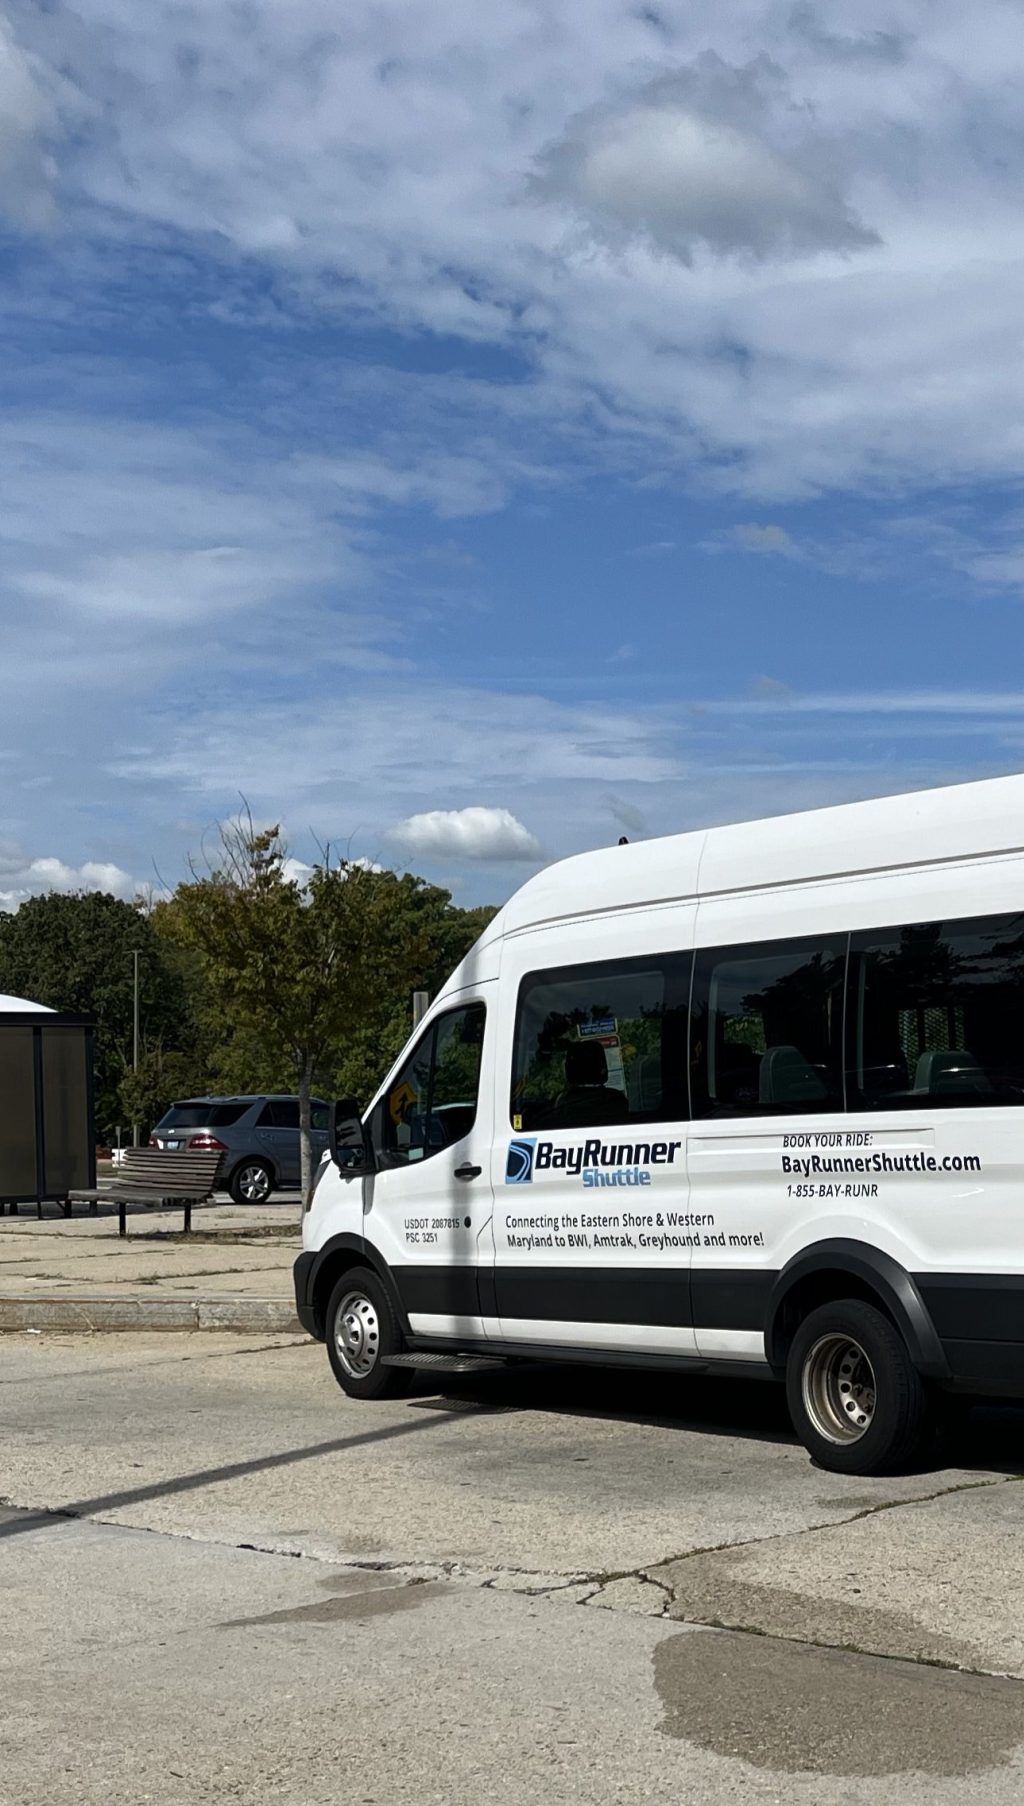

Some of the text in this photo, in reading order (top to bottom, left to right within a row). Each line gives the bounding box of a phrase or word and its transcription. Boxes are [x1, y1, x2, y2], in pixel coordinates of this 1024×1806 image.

[782, 1133, 874, 1148] BOOK YOUR RIDE:
[535, 1139, 682, 1176] BayRunner
[781, 1152, 982, 1178] BayRunnerShuttle.com
[582, 1167, 652, 1188] Shuttle
[787, 1184, 879, 1198] 1-855-BAY-RUNR
[404, 1218, 429, 1229] USDOT
[505, 1212, 715, 1232] Connecting the Eastern Shore & Western
[405, 1232, 438, 1243] PSC 3251
[507, 1231, 765, 1251] Maryland to BWI, Amtrak, Greyhound and more!
